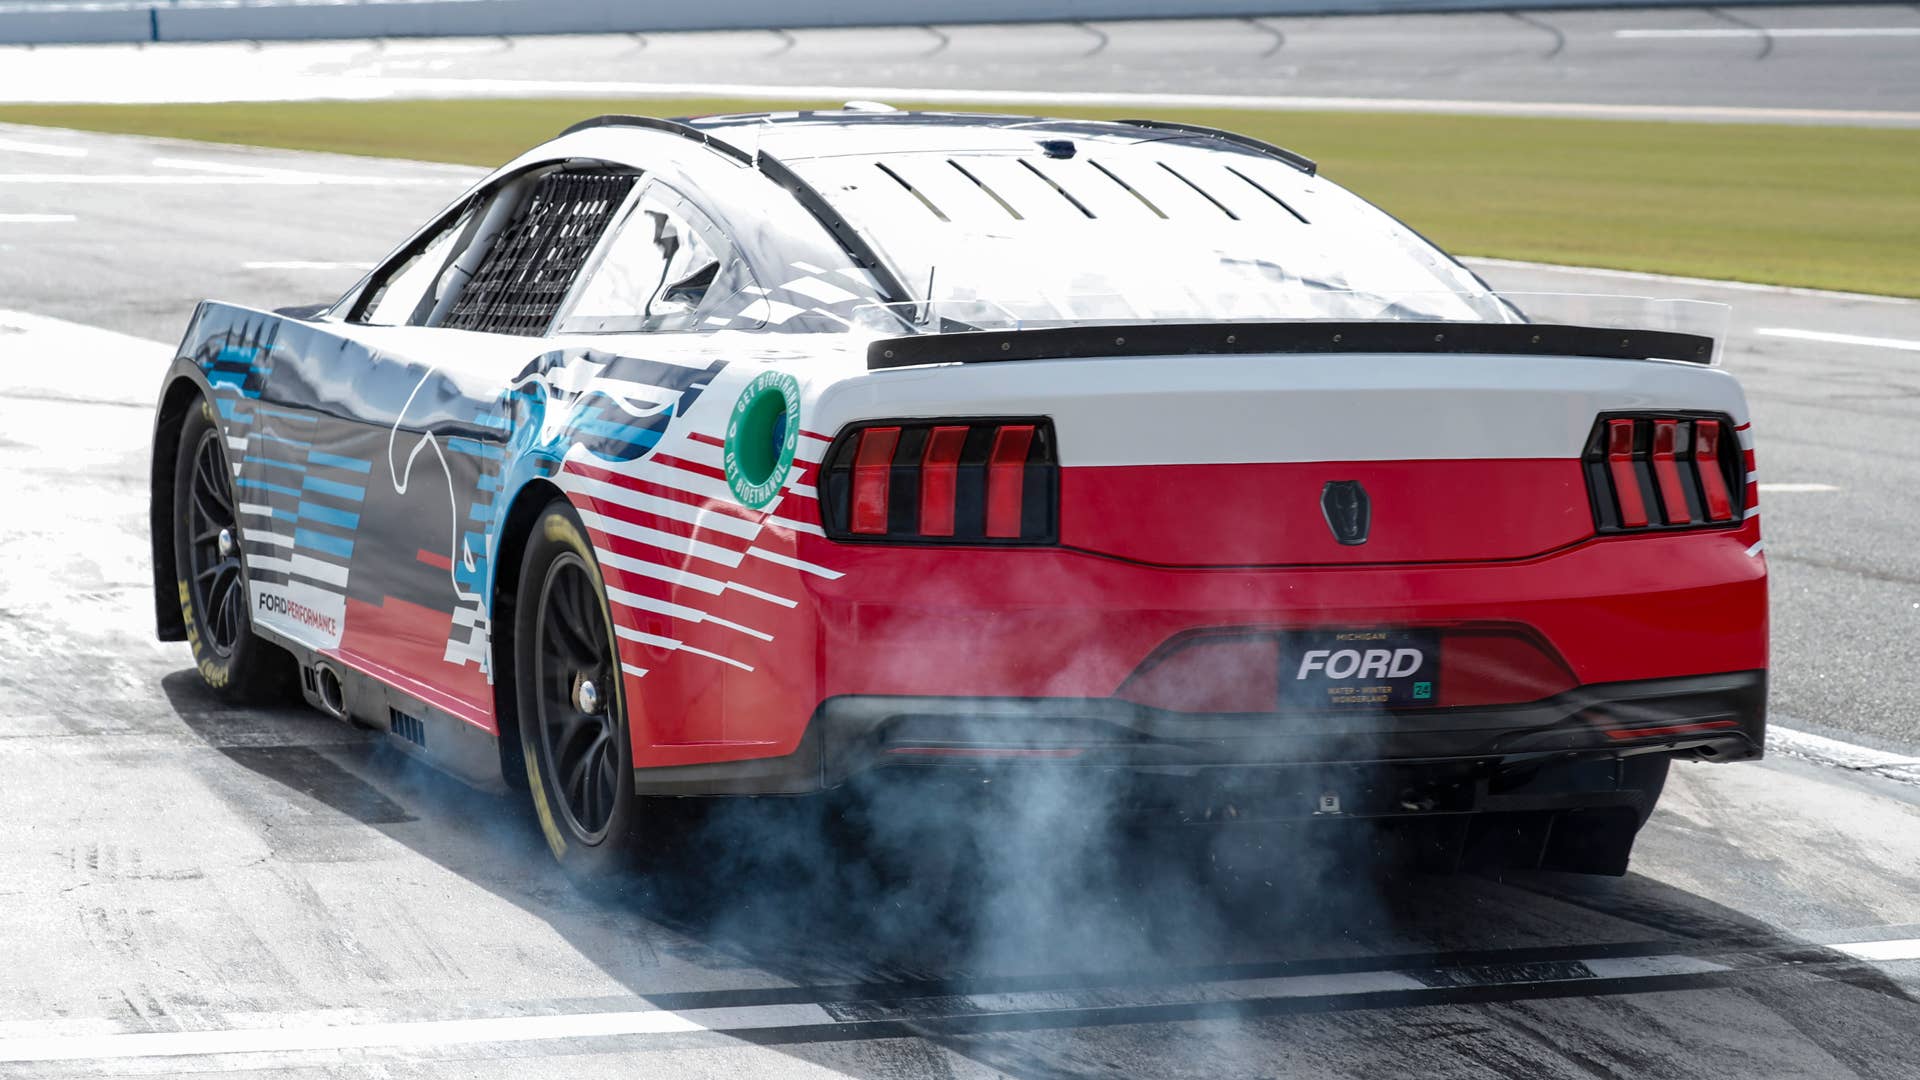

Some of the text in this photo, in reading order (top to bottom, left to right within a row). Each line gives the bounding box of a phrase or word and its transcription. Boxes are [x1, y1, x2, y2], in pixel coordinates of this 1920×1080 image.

[738, 372, 799, 425] GET BIOETHANOL
[726, 452, 788, 504] GET BIOETHANOL
[259, 592, 336, 637] FORD PERFORMANCE
[1336, 632, 1387, 641] MICHIGAN
[1296, 648, 1424, 680] FORD
[1328, 687, 1354, 695] WATER
[1362, 686, 1393, 695] WINTER
[1332, 695, 1389, 703] WONDERLAND
[1415, 685, 1429, 696] 24
